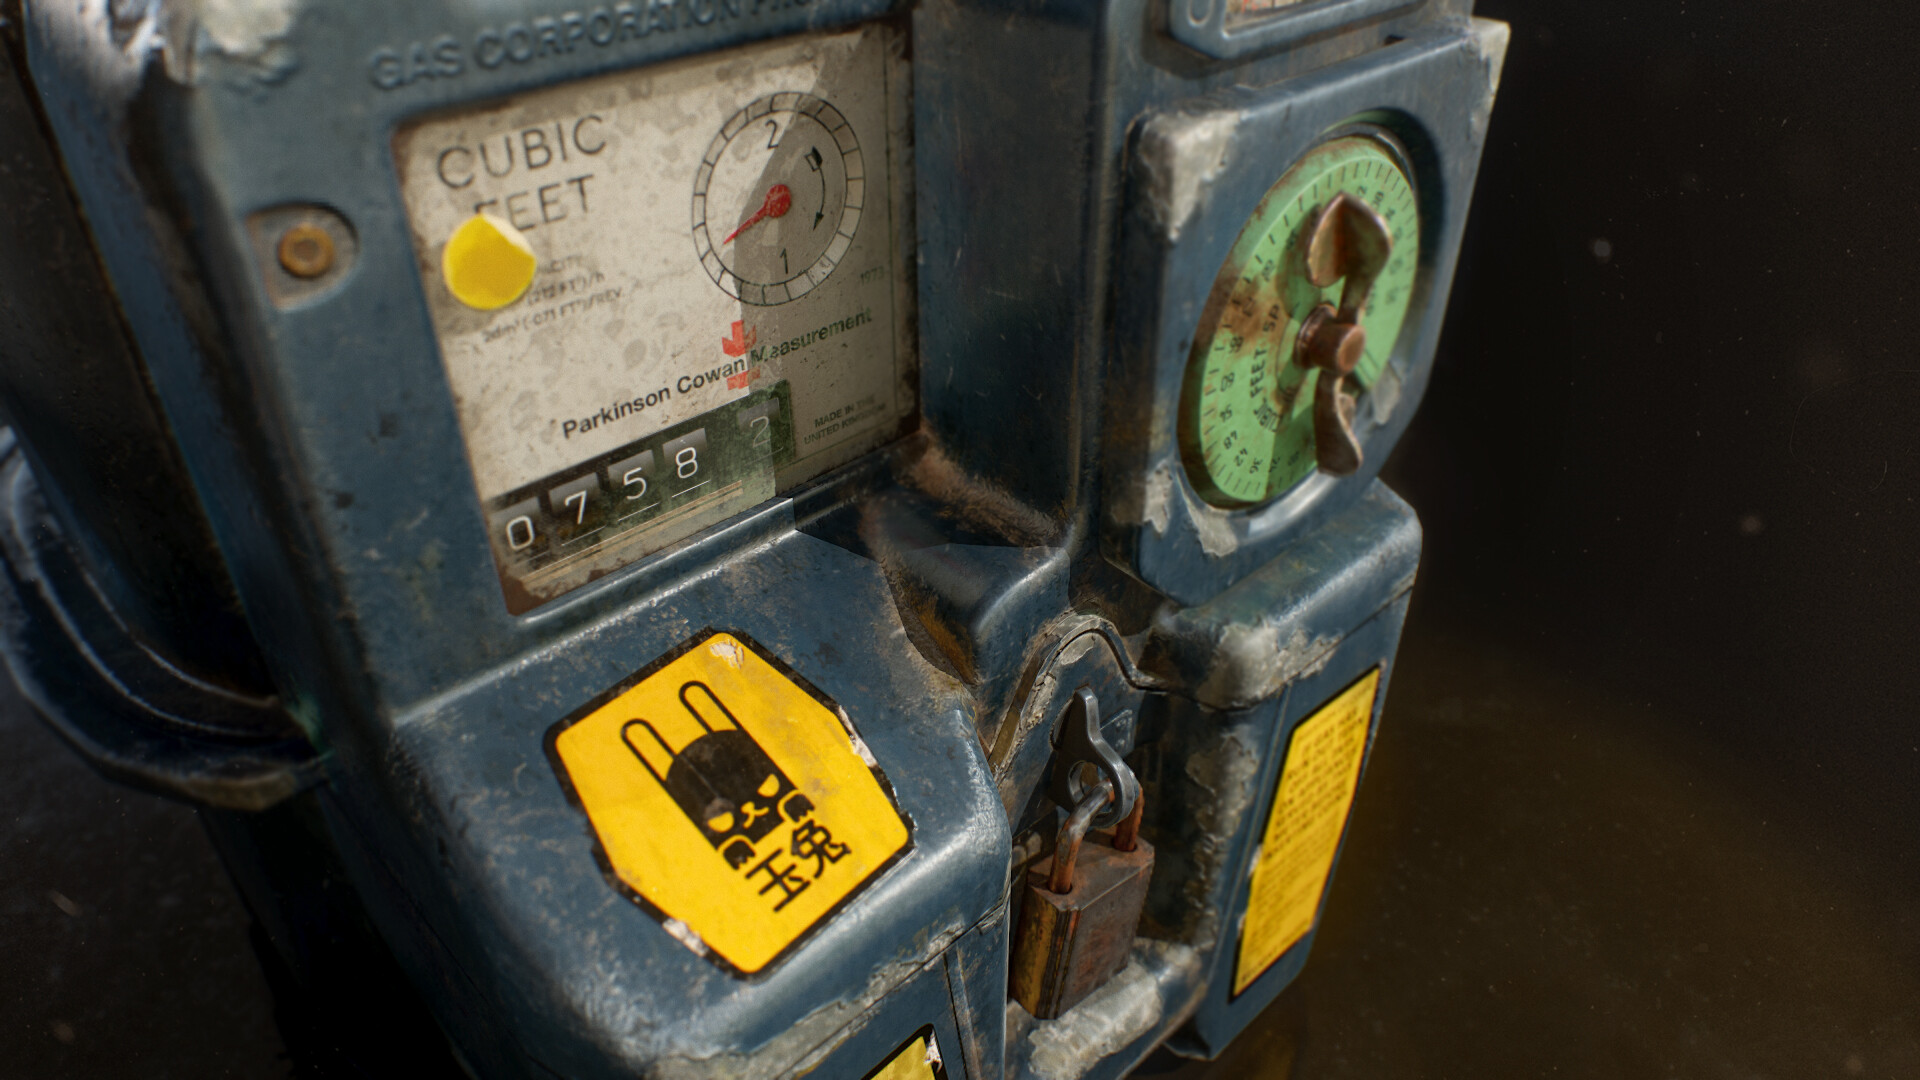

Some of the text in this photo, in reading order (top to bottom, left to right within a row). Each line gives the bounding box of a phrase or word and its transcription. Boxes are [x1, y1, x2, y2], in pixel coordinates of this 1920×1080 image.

[368, 0, 740, 90] GAS CORPORATION
[437, 114, 606, 189] CUBIC
[765, 119, 779, 150] 2
[779, 248, 789, 276] 1
[562, 306, 873, 440] Parkinson Cowan Measurement
[1250, 348, 1267, 399] FEET
[803, 422, 841, 446] UNITED
[814, 408, 842, 429] MADE
[745, 818, 853, 914] 玉兔
